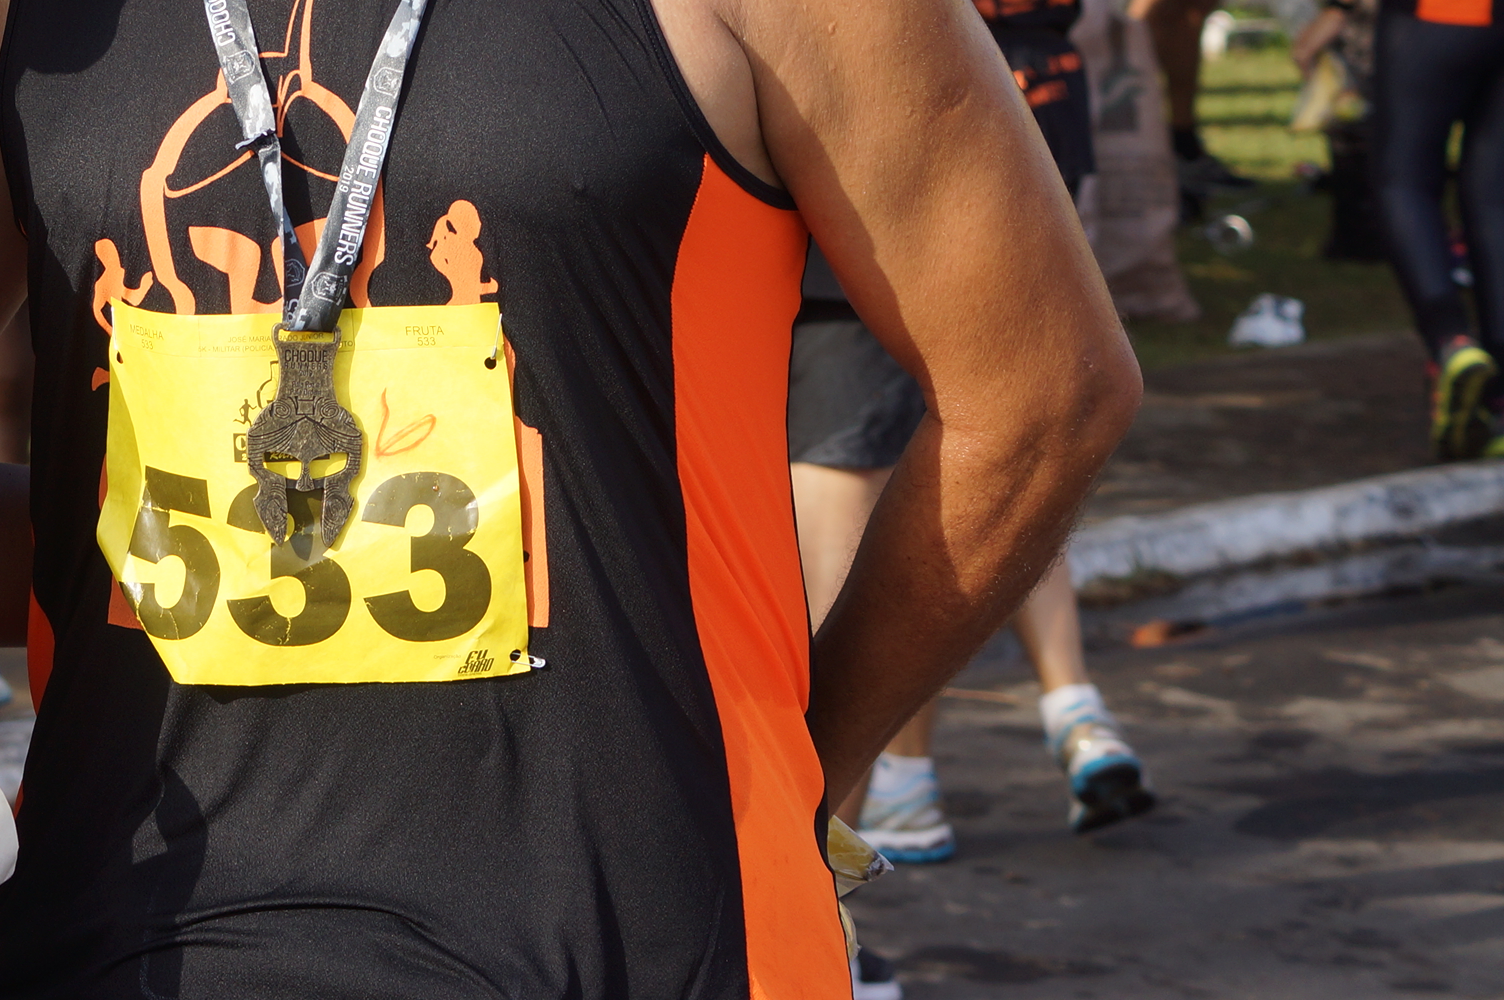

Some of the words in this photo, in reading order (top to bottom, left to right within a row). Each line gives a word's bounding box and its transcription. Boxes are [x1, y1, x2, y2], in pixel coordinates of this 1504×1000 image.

[356, 105, 393, 179] CHOQUE
[339, 167, 354, 193] 2019
[334, 180, 373, 266] RUNNERS
[130, 324, 164, 340] MEDALHA
[405, 326, 444, 336] FRUTA
[141, 339, 153, 350] 533
[228, 335, 246, 343] JOSÉ
[278, 334, 299, 342] RADO
[417, 337, 436, 346] 533
[213, 345, 241, 353] MILITAR
[284, 349, 328, 363] CHOQUE
[284, 362, 328, 370] RUNNERS
[120, 465, 492, 647] 533
